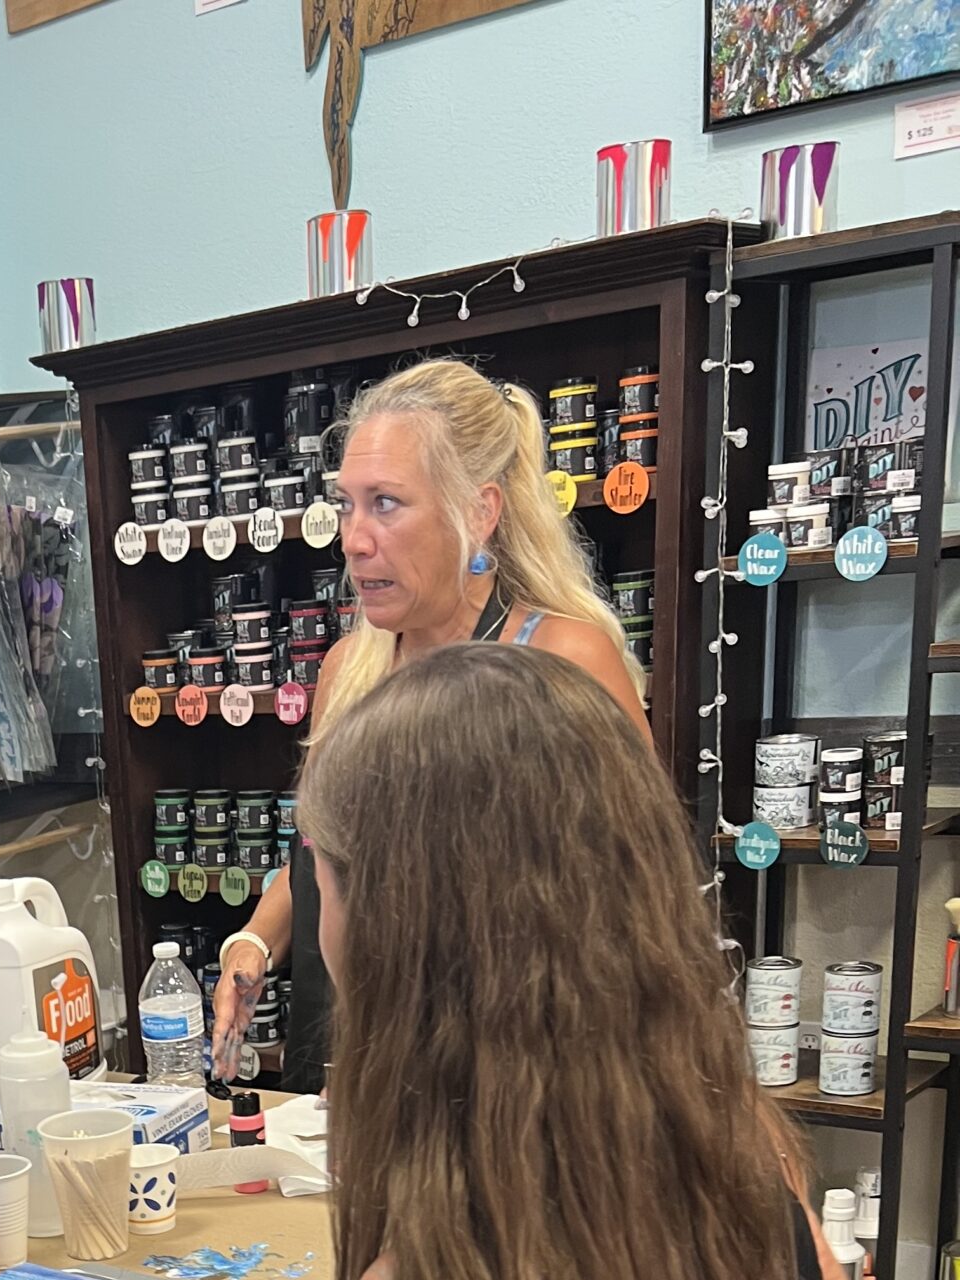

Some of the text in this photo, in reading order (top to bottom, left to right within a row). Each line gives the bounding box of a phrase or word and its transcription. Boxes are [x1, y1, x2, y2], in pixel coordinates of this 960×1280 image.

[917, 126, 934, 137] 125
[813, 353, 922, 451] DIY
[618, 466, 635, 486] Fire
[812, 461, 837, 485] DIY
[869, 453, 895, 479] DIY
[746, 545, 780, 559] Clear
[839, 534, 883, 555] White
[747, 562, 777, 575] Wax
[841, 558, 877, 576] Wax
[875, 752, 900, 773] DIY
[867, 797, 892, 818] DIY
[826, 829, 863, 848] Black
[828, 847, 858, 864] Wax
[49, 983, 91, 1034] Food
[151, 1122, 168, 1139] VINYL
[168, 1114, 184, 1129] EXAM
[183, 1101, 205, 1120] GLOVES
